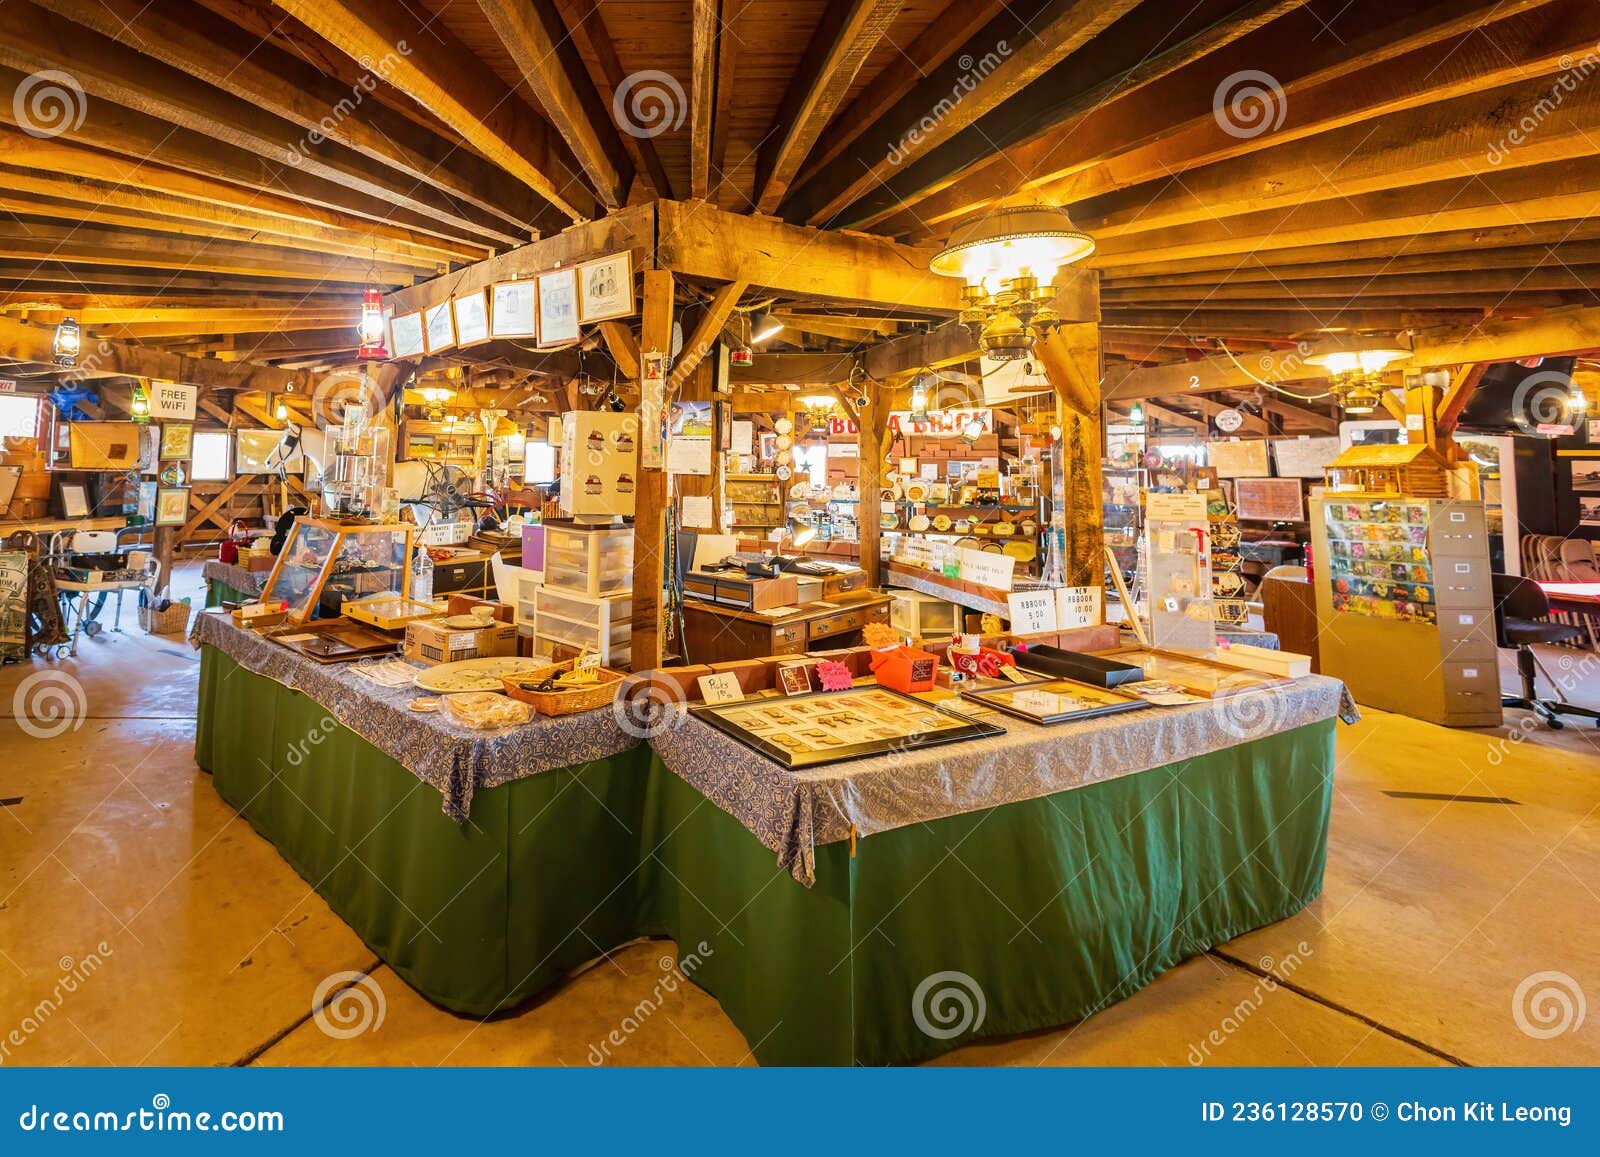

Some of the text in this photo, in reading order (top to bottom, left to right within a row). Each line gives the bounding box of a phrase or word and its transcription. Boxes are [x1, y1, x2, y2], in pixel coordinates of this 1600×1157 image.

[286, 381, 294, 392] 6
[1189, 376, 1200, 389] 2
[161, 389, 187, 400] FREE
[832, 416, 861, 434] BU
[1075, 587, 1088, 595] NEW
